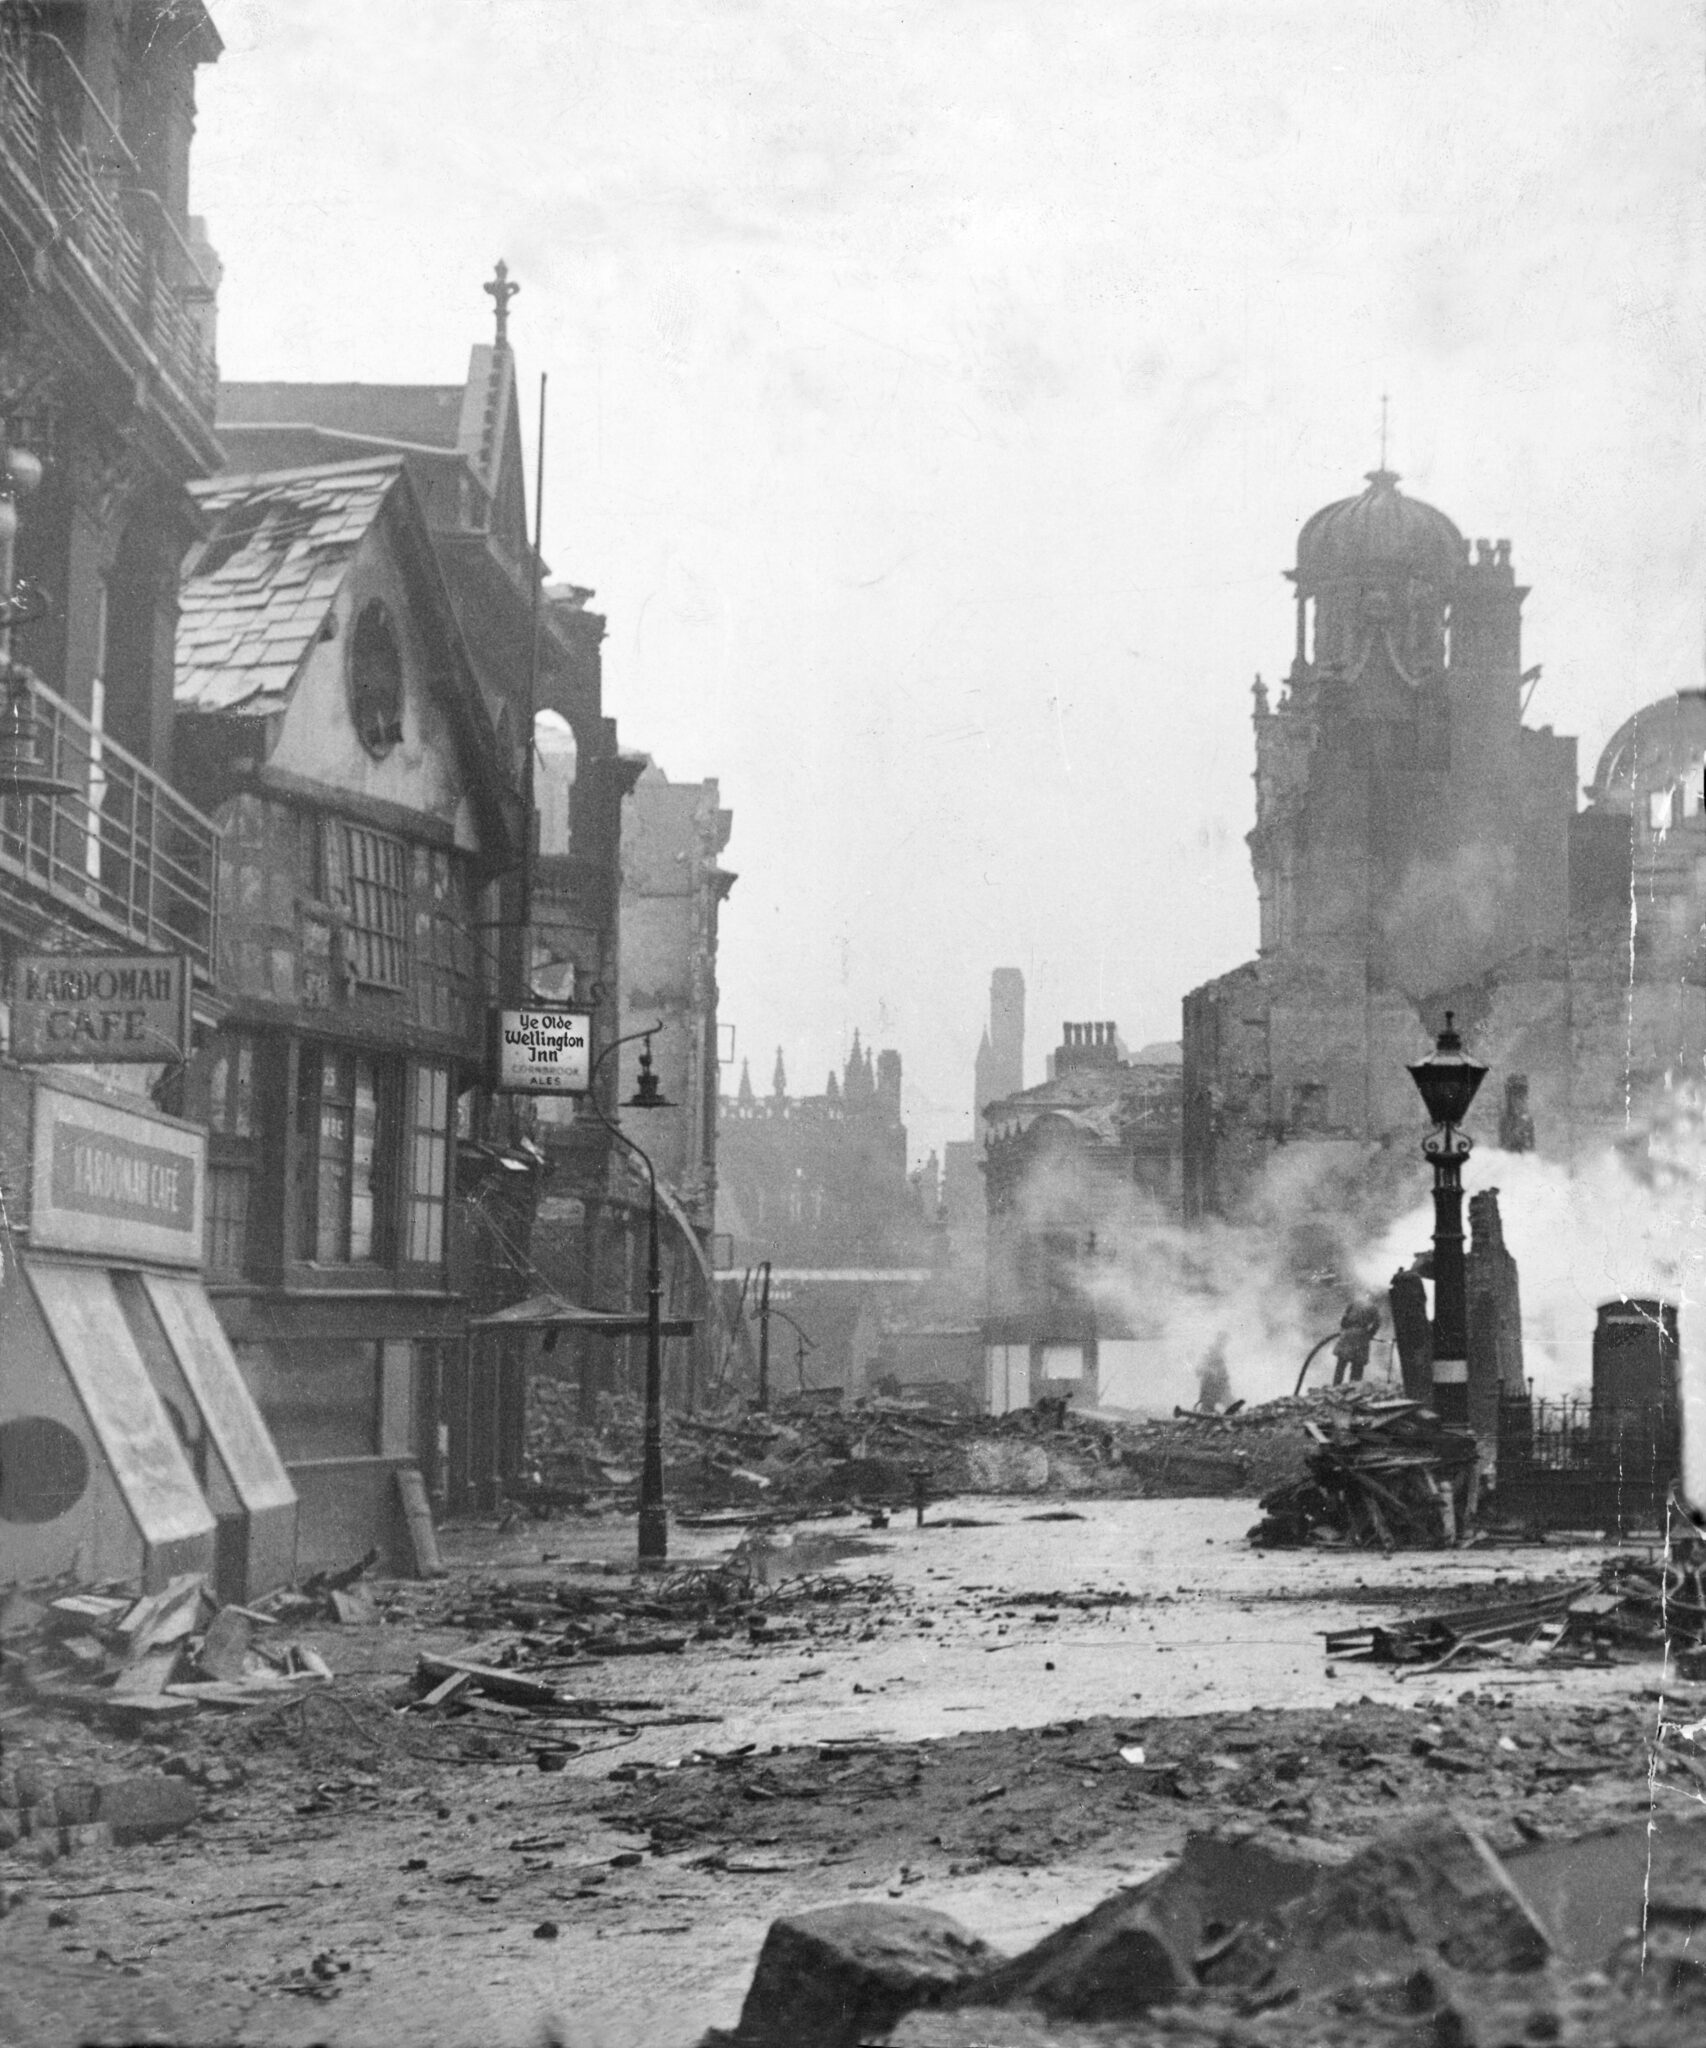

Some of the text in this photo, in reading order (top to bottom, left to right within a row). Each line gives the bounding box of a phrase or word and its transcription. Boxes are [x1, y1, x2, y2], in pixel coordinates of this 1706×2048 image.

[26, 968, 171, 1001] KARDOMAH
[520, 1014, 572, 1030] Ye Olde
[505, 1031, 584, 1052] Wellington
[528, 1047, 558, 1062] Inn
[530, 1076, 562, 1086] ALES
